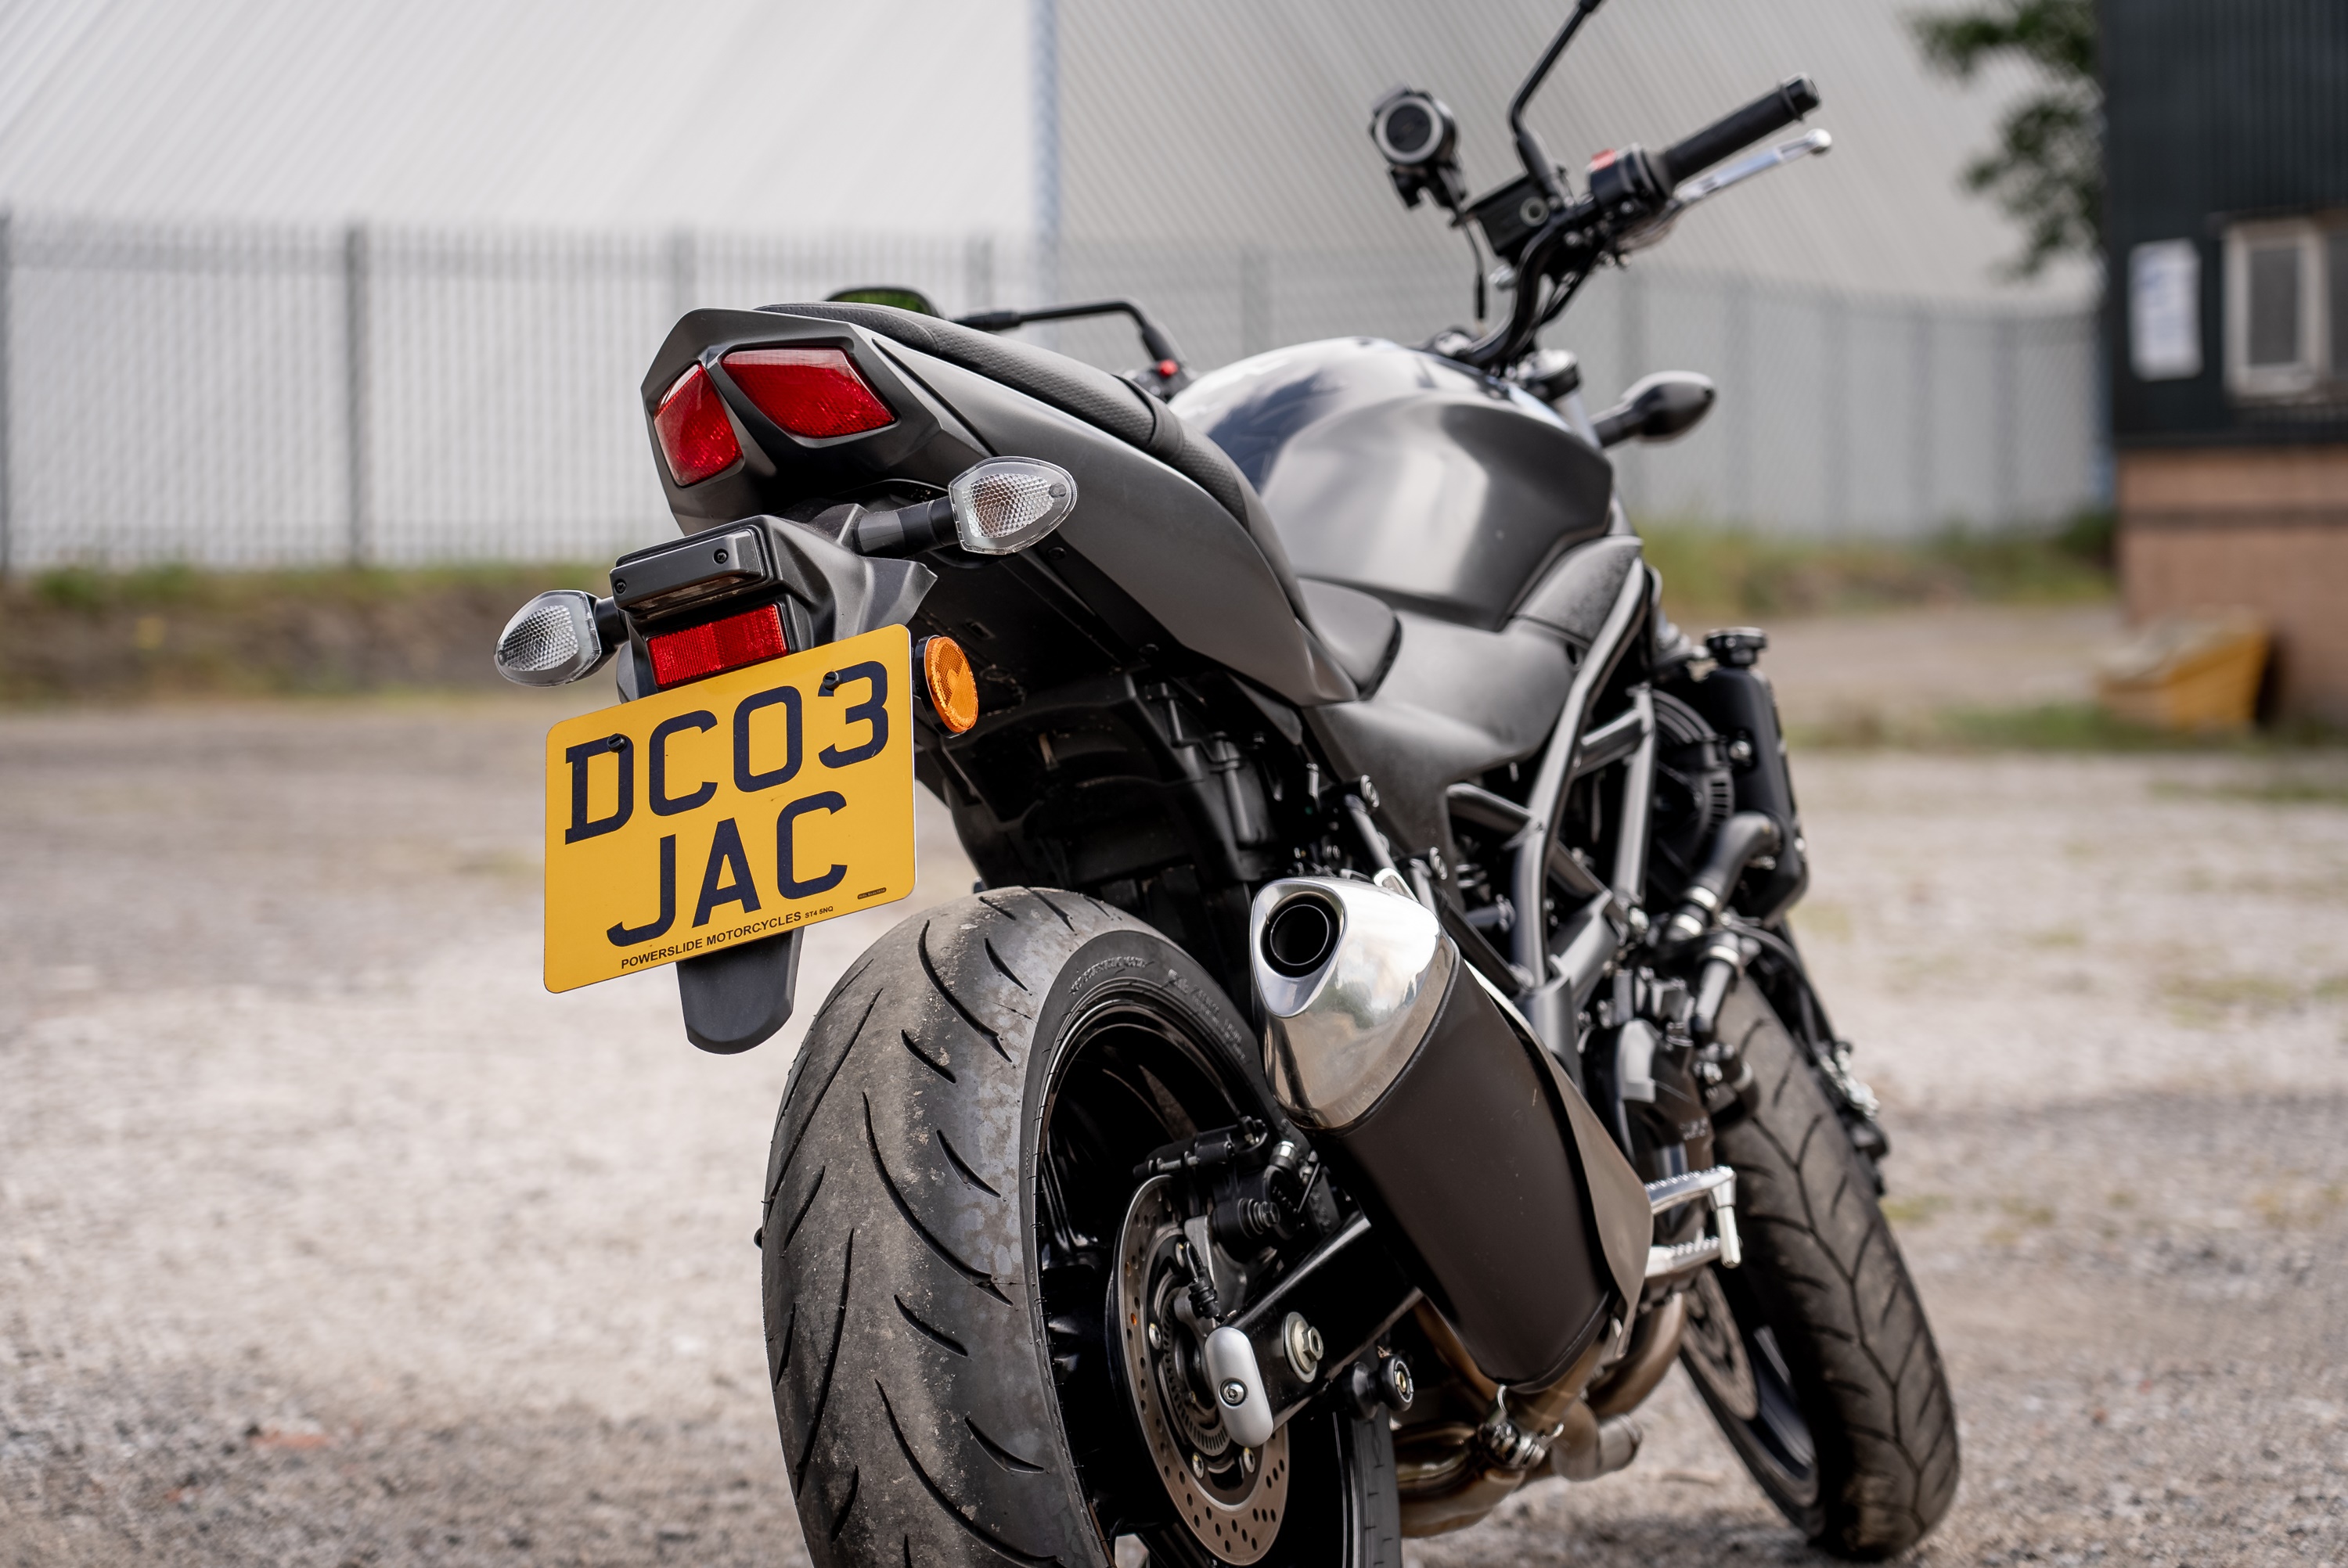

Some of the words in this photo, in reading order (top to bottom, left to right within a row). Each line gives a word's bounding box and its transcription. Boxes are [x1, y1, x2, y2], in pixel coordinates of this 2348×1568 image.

[565, 660, 889, 845] DC03
[606, 790, 848, 948] JAC
[621, 938, 703, 969] POWERSLIDE
[707, 912, 801, 946] MOTORCYCLES
[805, 910, 818, 919] ST4
[819, 905, 834, 915] 5NQ
